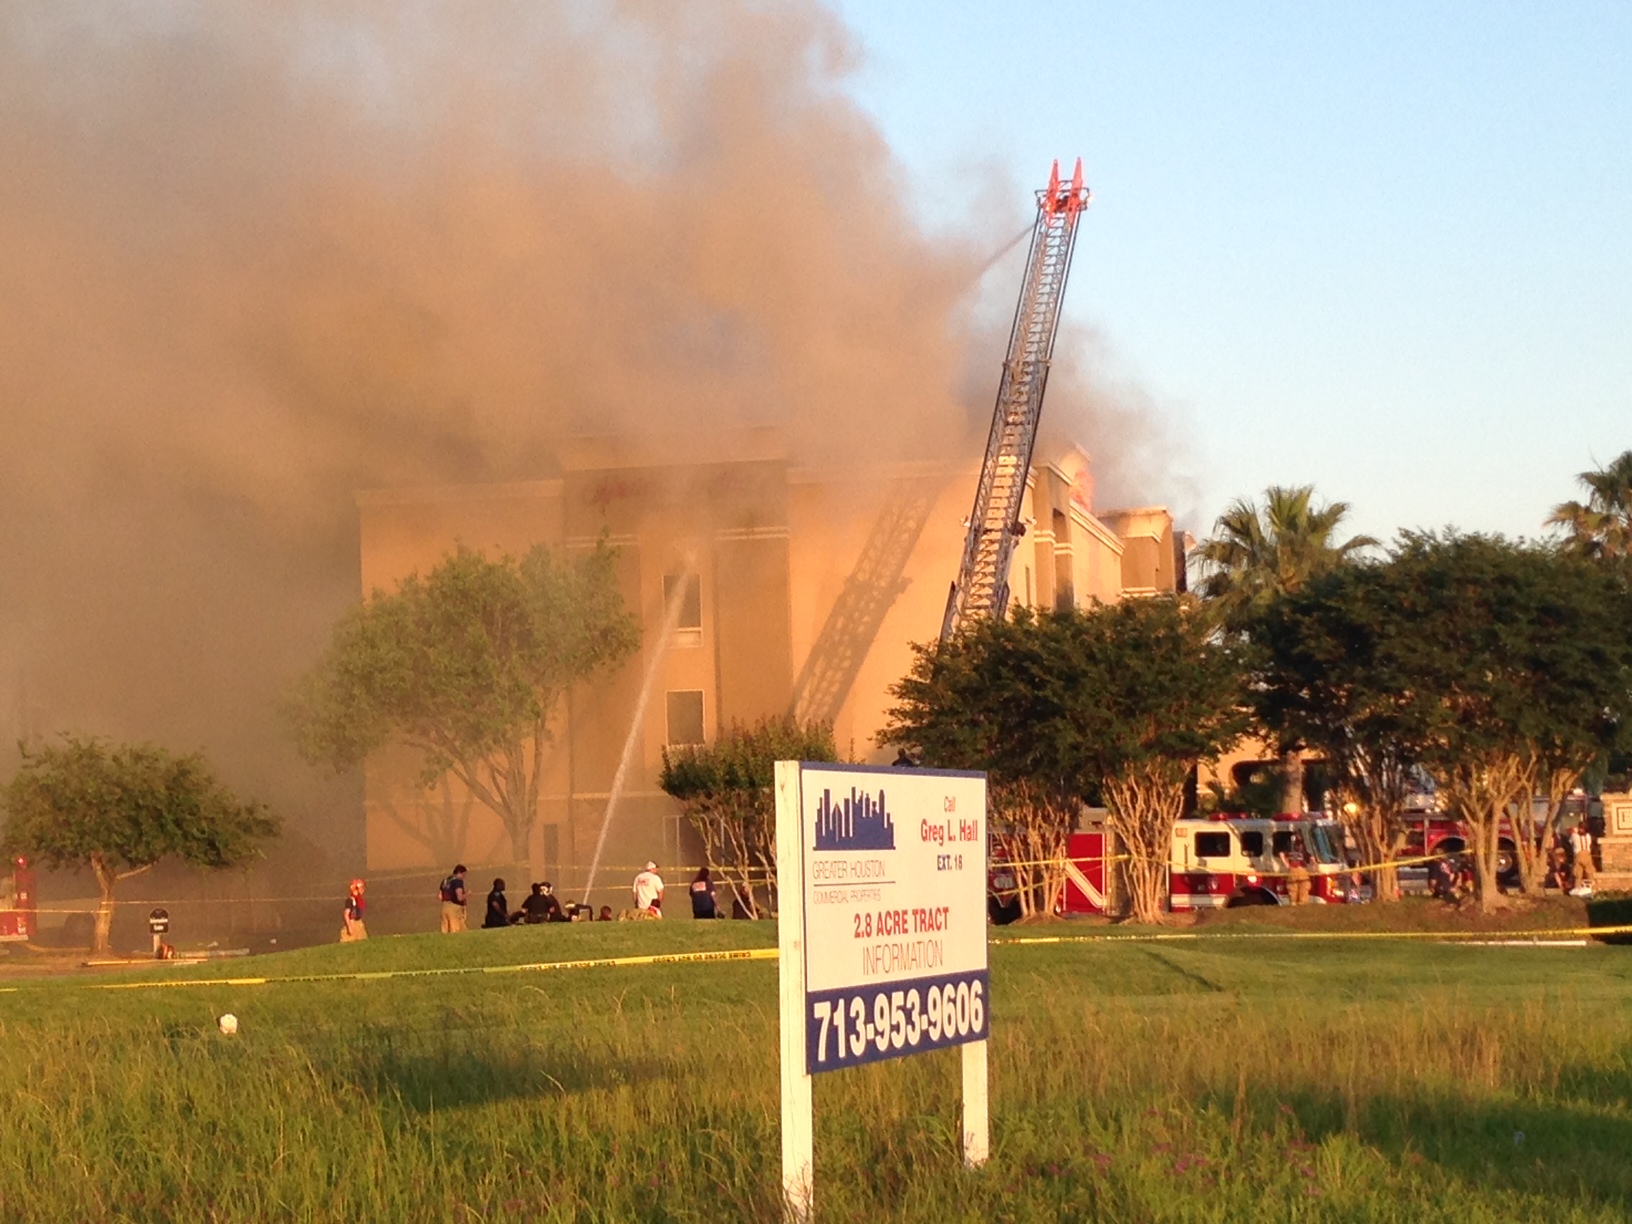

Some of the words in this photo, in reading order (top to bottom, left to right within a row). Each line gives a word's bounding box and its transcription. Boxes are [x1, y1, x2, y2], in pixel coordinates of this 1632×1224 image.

[944, 796, 956, 812] Call
[921, 819, 944, 846] Greg
[948, 820, 956, 842] L.
[959, 820, 978, 841] Hall
[813, 861, 847, 880] GREATER
[850, 860, 885, 878] HOUSTON
[937, 855, 952, 871] EXT.
[813, 890, 848, 904] COMMERCIAL
[850, 889, 881, 902] PROPERTIES
[854, 913, 872, 939] 2.8
[876, 909, 908, 936] ACRE
[912, 907, 949, 933] TRACT
[862, 940, 943, 975] INFORMATION
[813, 979, 983, 1062] 713-953-9606
